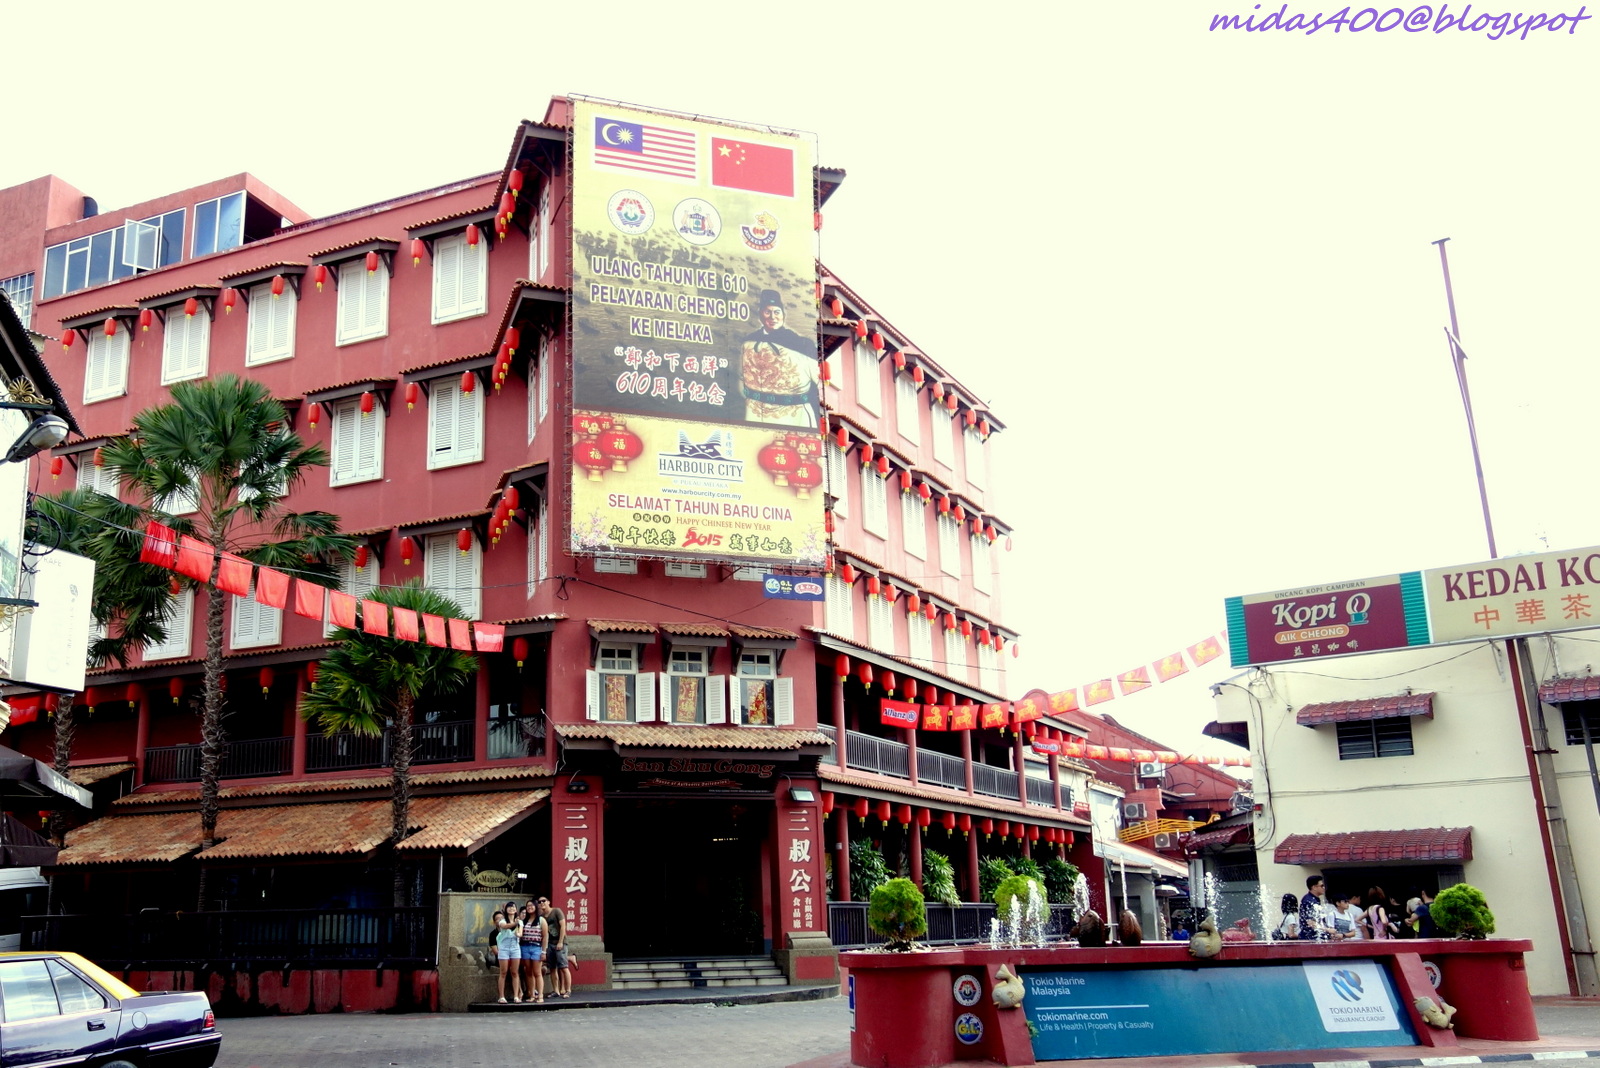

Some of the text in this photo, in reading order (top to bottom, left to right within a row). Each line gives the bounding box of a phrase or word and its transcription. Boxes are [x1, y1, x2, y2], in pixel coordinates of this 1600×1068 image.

[592, 256, 747, 293] ULANG TAHUN KE 610
[591, 284, 749, 321] PELAYARAN CHENG HO
[631, 317, 713, 344] KE MELAKA
[613, 438, 626, 450] 福
[659, 458, 743, 477] HARBOUR CITY
[775, 454, 787, 465] 福
[662, 488, 741, 500] www.harbourcity.com.my
[608, 493, 792, 521] SELAMAT TAHUN BARU CINA
[682, 527, 724, 547] 2015
[1443, 553, 1600, 602] KEDAI KO
[1275, 590, 1304, 599] UNCANG
[1326, 581, 1366, 592] CAMPURAN
[1271, 596, 1337, 629] Kopi
[1473, 593, 1592, 630] 中華茶
[1280, 627, 1345, 642] AIK CHEONG
[621, 756, 775, 779] San Shu Gong
[563, 806, 589, 894] 三叔公
[788, 809, 812, 893] 三叔公
[1029, 977, 1085, 986] Tokio Marine
[1031, 986, 1071, 997] Malaysia
[1037, 1012, 1108, 1022] tokiomarine.com
[1354, 1006, 1384, 1014] MARINE
[1040, 1023, 1053, 1031] Life
[1061, 1022, 1084, 1030] Health
[1088, 1022, 1116, 1031] Property
[1124, 1021, 1154, 1030] Casualty
